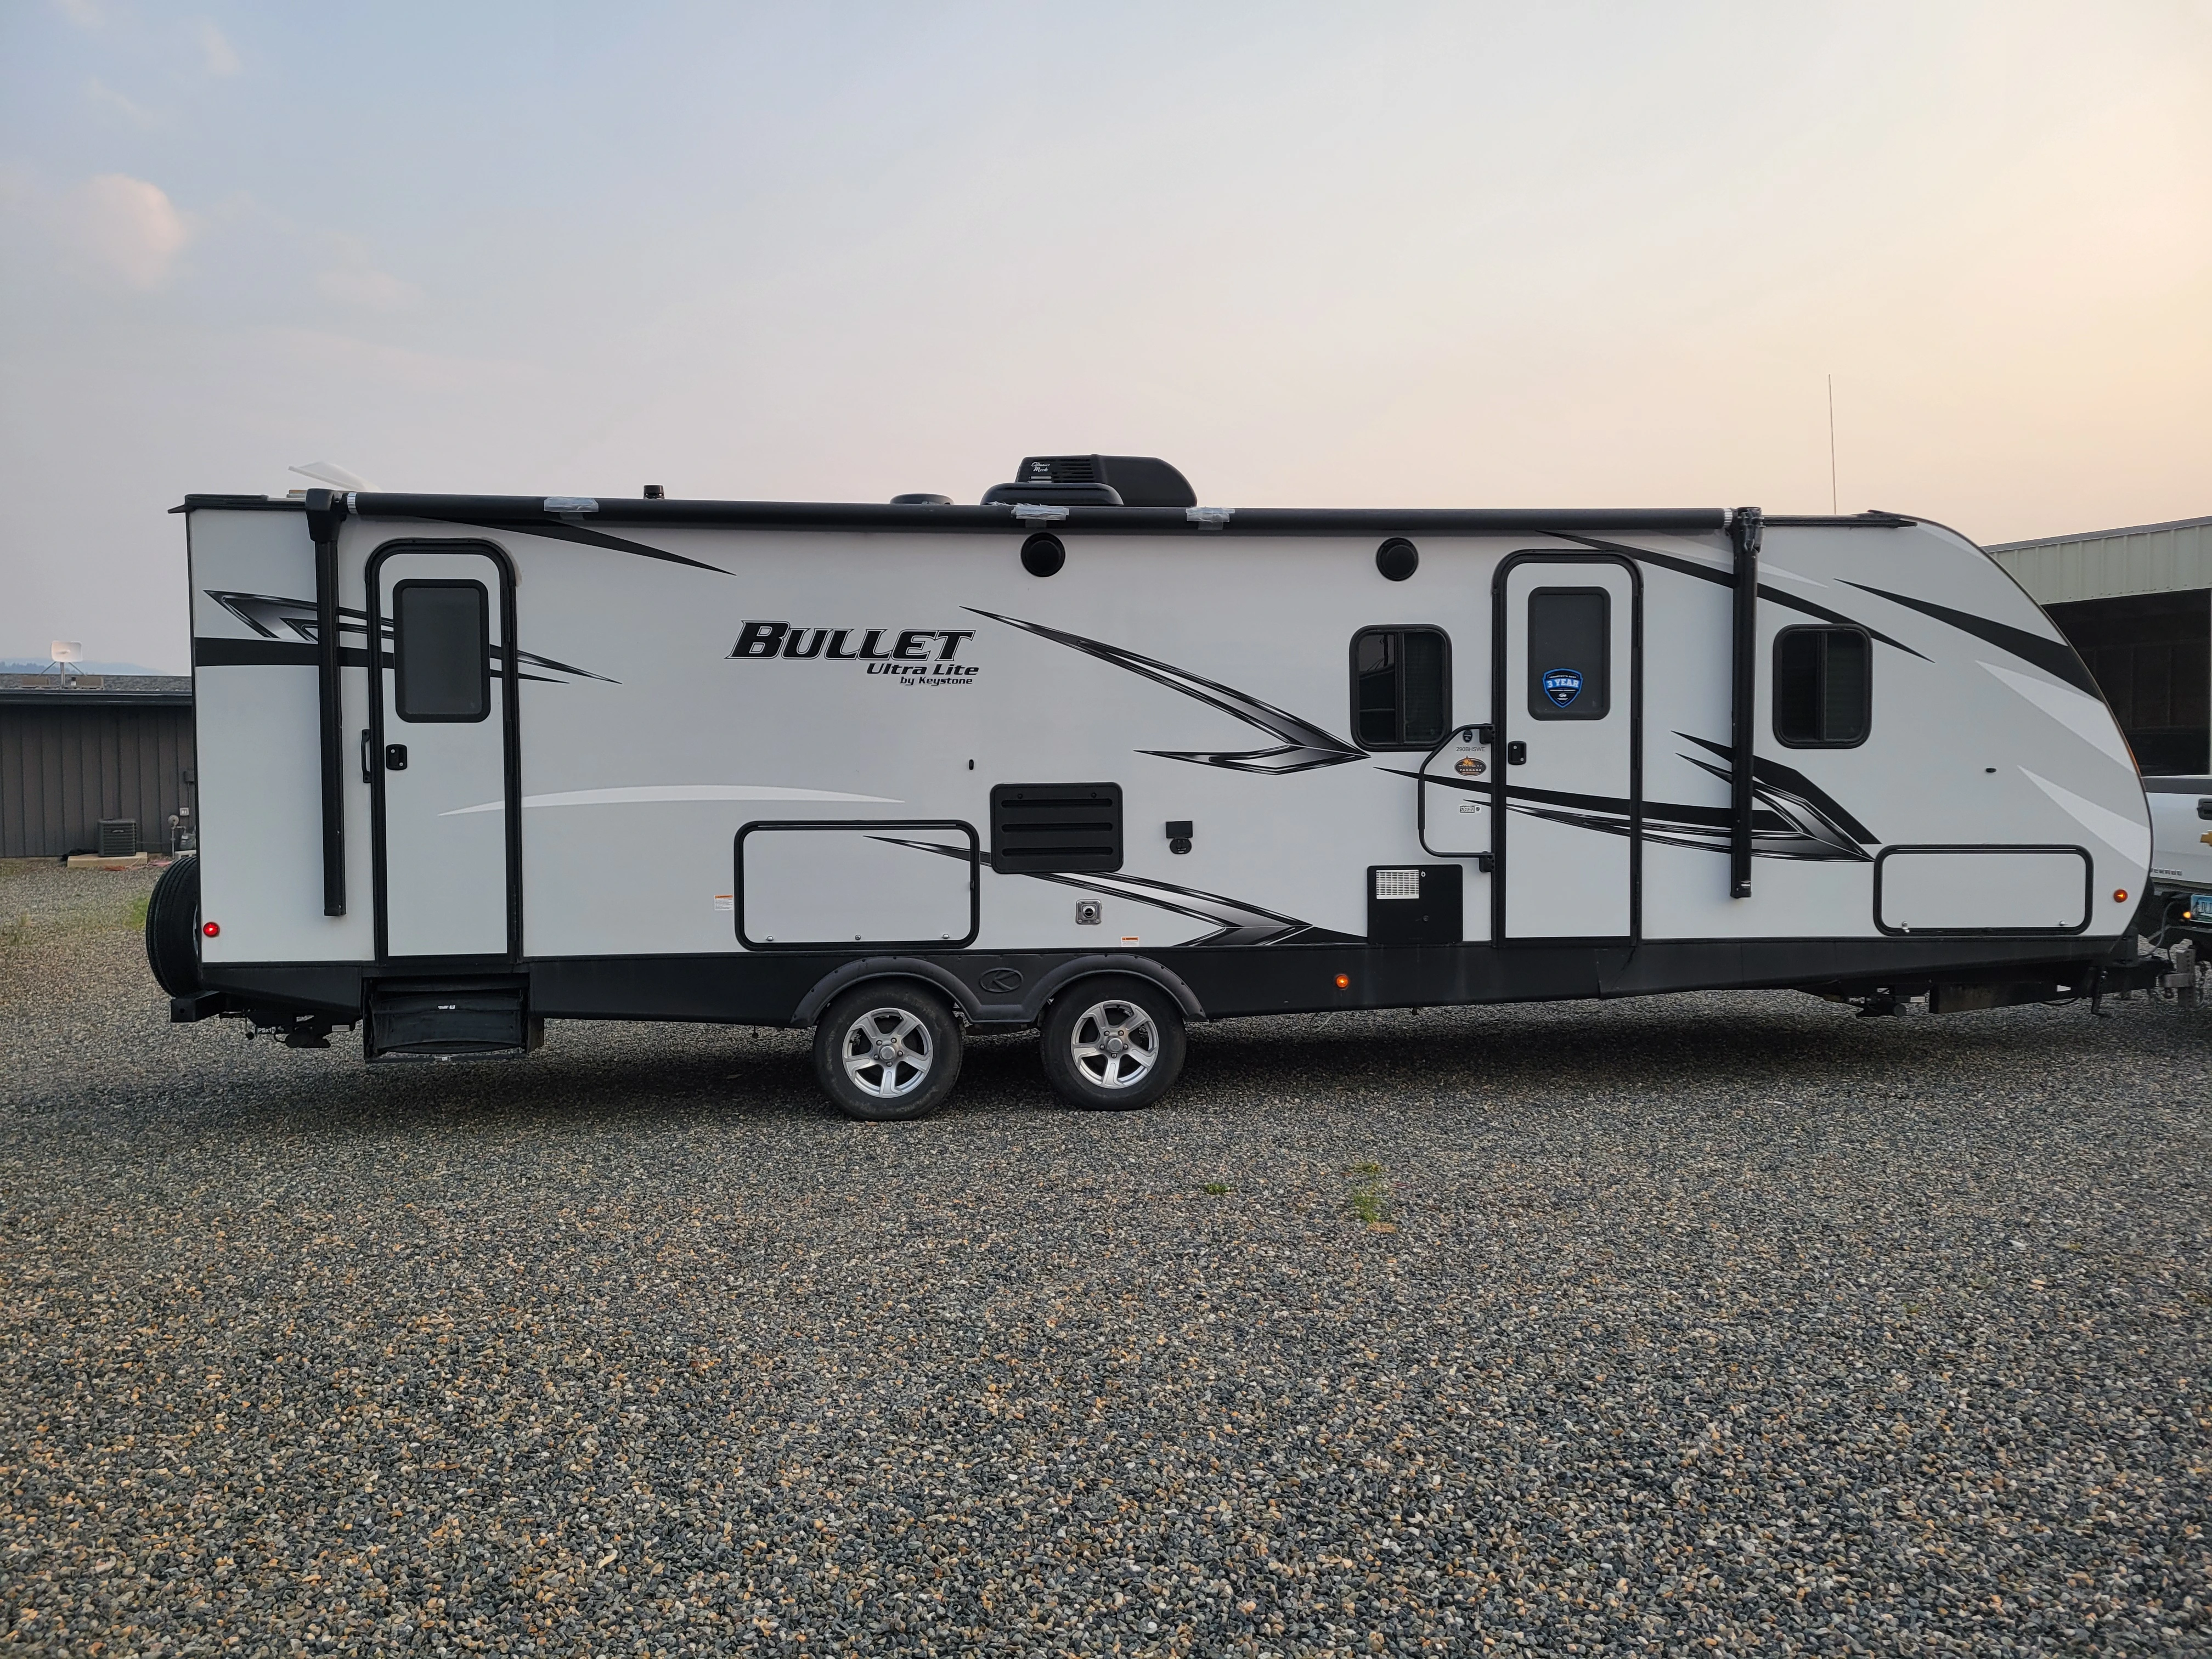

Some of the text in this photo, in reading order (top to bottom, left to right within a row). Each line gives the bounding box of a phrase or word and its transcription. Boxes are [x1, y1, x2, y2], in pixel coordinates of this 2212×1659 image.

[724, 620, 976, 661] BULLET
[866, 663, 979, 675] Ultra Lite
[900, 676, 973, 686] by Keystone
[1554, 679, 1579, 687] YEAR
